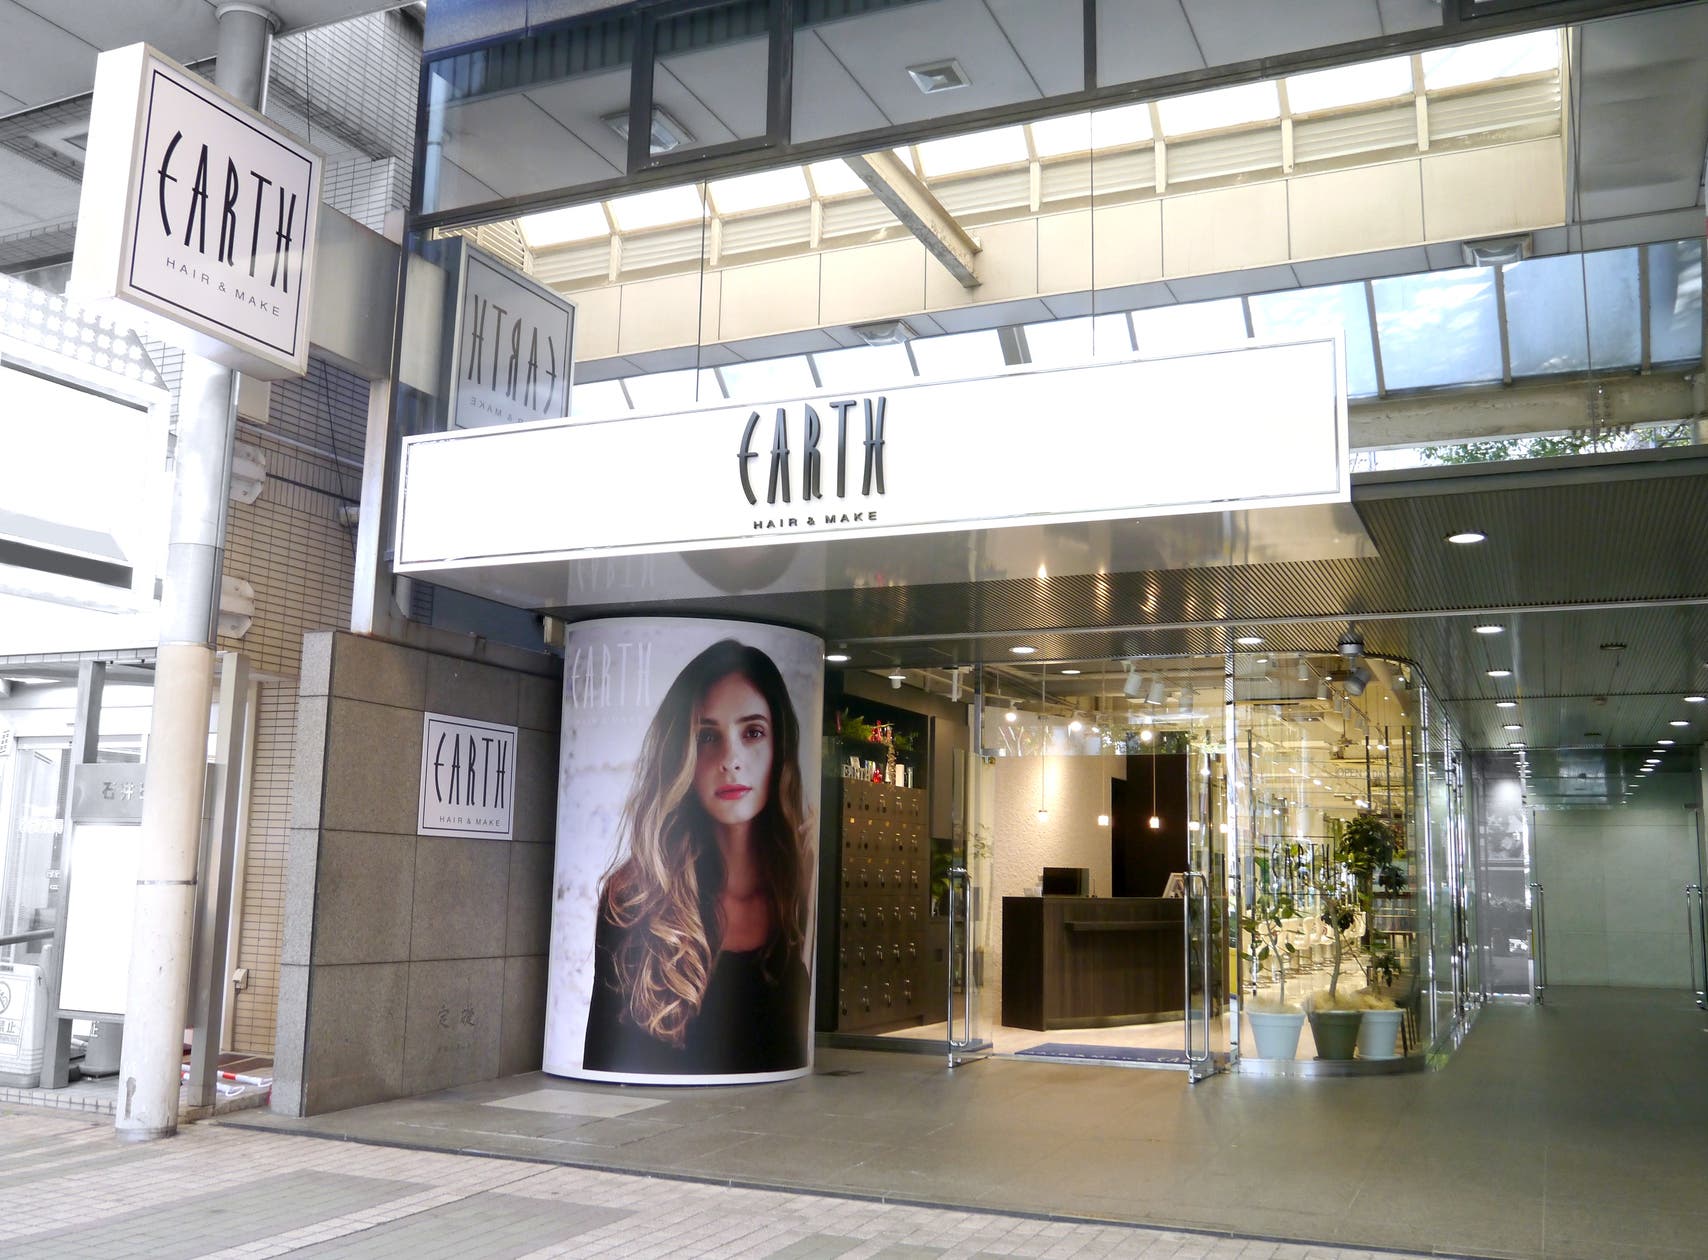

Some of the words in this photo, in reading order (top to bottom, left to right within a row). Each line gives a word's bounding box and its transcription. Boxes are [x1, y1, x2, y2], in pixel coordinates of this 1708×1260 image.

[158, 130, 296, 293] EARTH
[166, 256, 210, 285] HAIR
[218, 281, 226, 292] &
[235, 288, 280, 317] MAKE
[737, 396, 886, 505] EARTH
[753, 518, 798, 530] HAIR
[807, 516, 815, 526] &
[825, 511, 878, 524] MAKE
[571, 642, 652, 709] EARTH
[434, 731, 508, 809] EARTH
[439, 815, 463, 825] HAIR
[475, 818, 500, 827] MAKE
